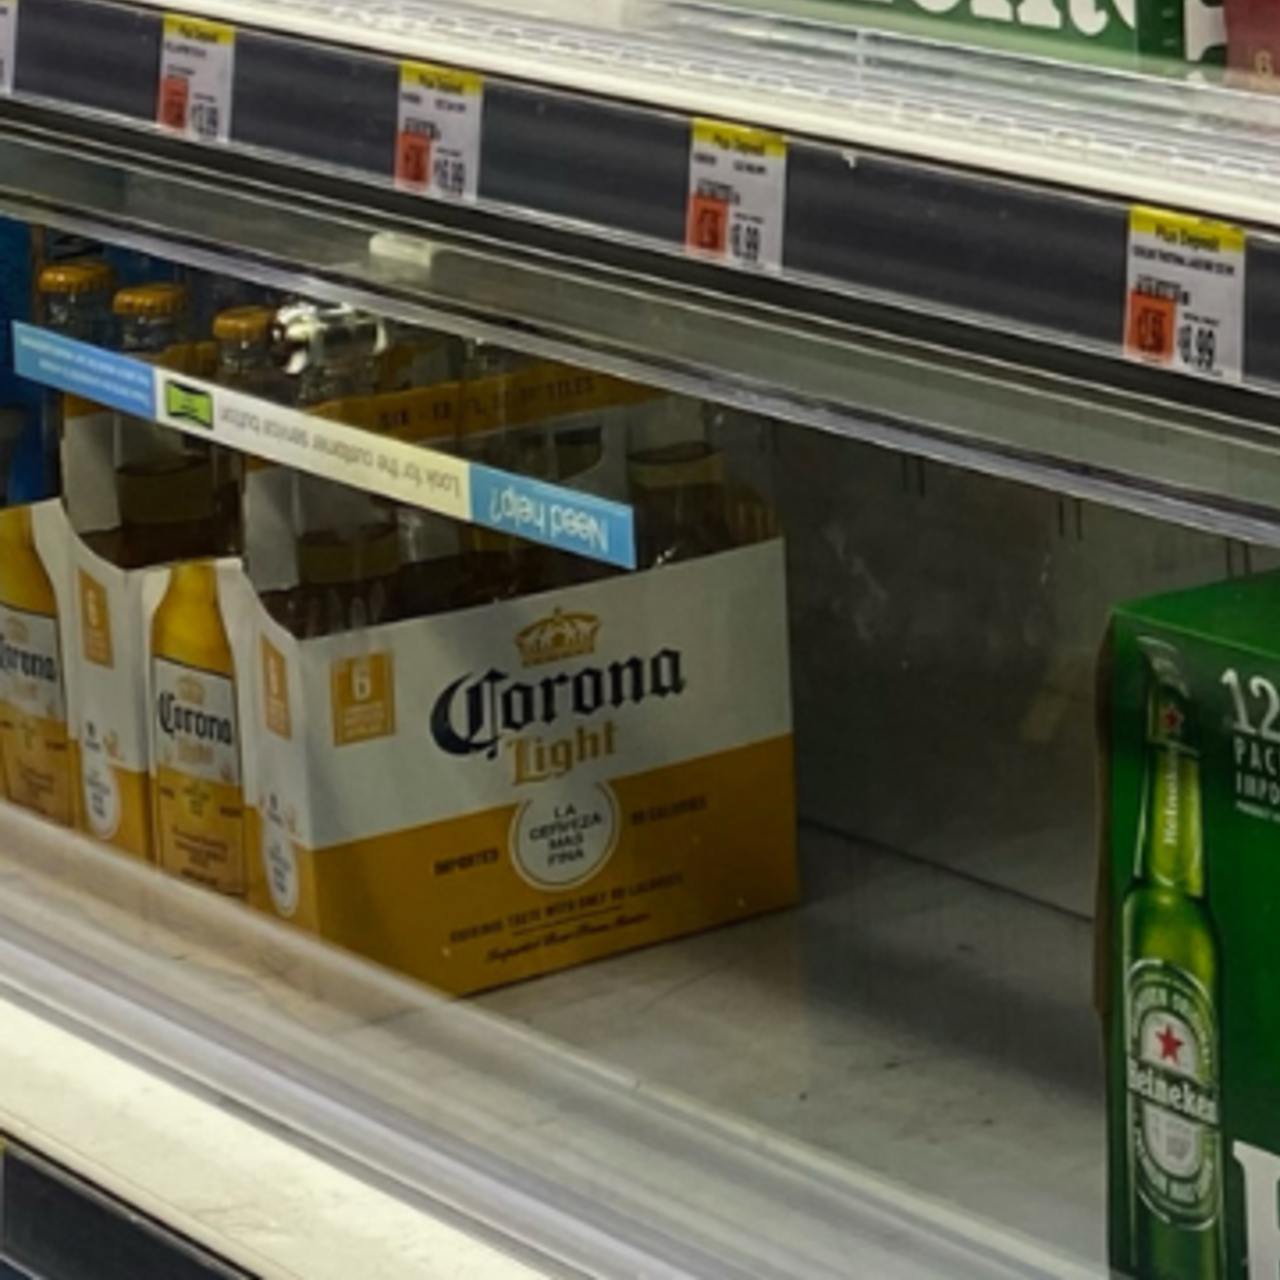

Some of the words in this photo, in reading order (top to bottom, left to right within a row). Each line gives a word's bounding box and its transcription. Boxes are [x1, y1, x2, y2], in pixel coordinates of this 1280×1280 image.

[312, 434, 374, 473] customer
[377, 453, 401, 480] the
[400, 461, 423, 487] for
[422, 466, 461, 500] Look
[487, 488, 547, 529] help?
[553, 505, 610, 554] Need
[159, 692, 235, 746] Corona
[429, 647, 687, 760] Corona
[506, 720, 618, 787] Light
[529, 810, 602, 842] CERVEZA
[553, 803, 577, 820] LA
[546, 848, 585, 868] FINA
[1128, 1062, 1219, 1125] Heineken
